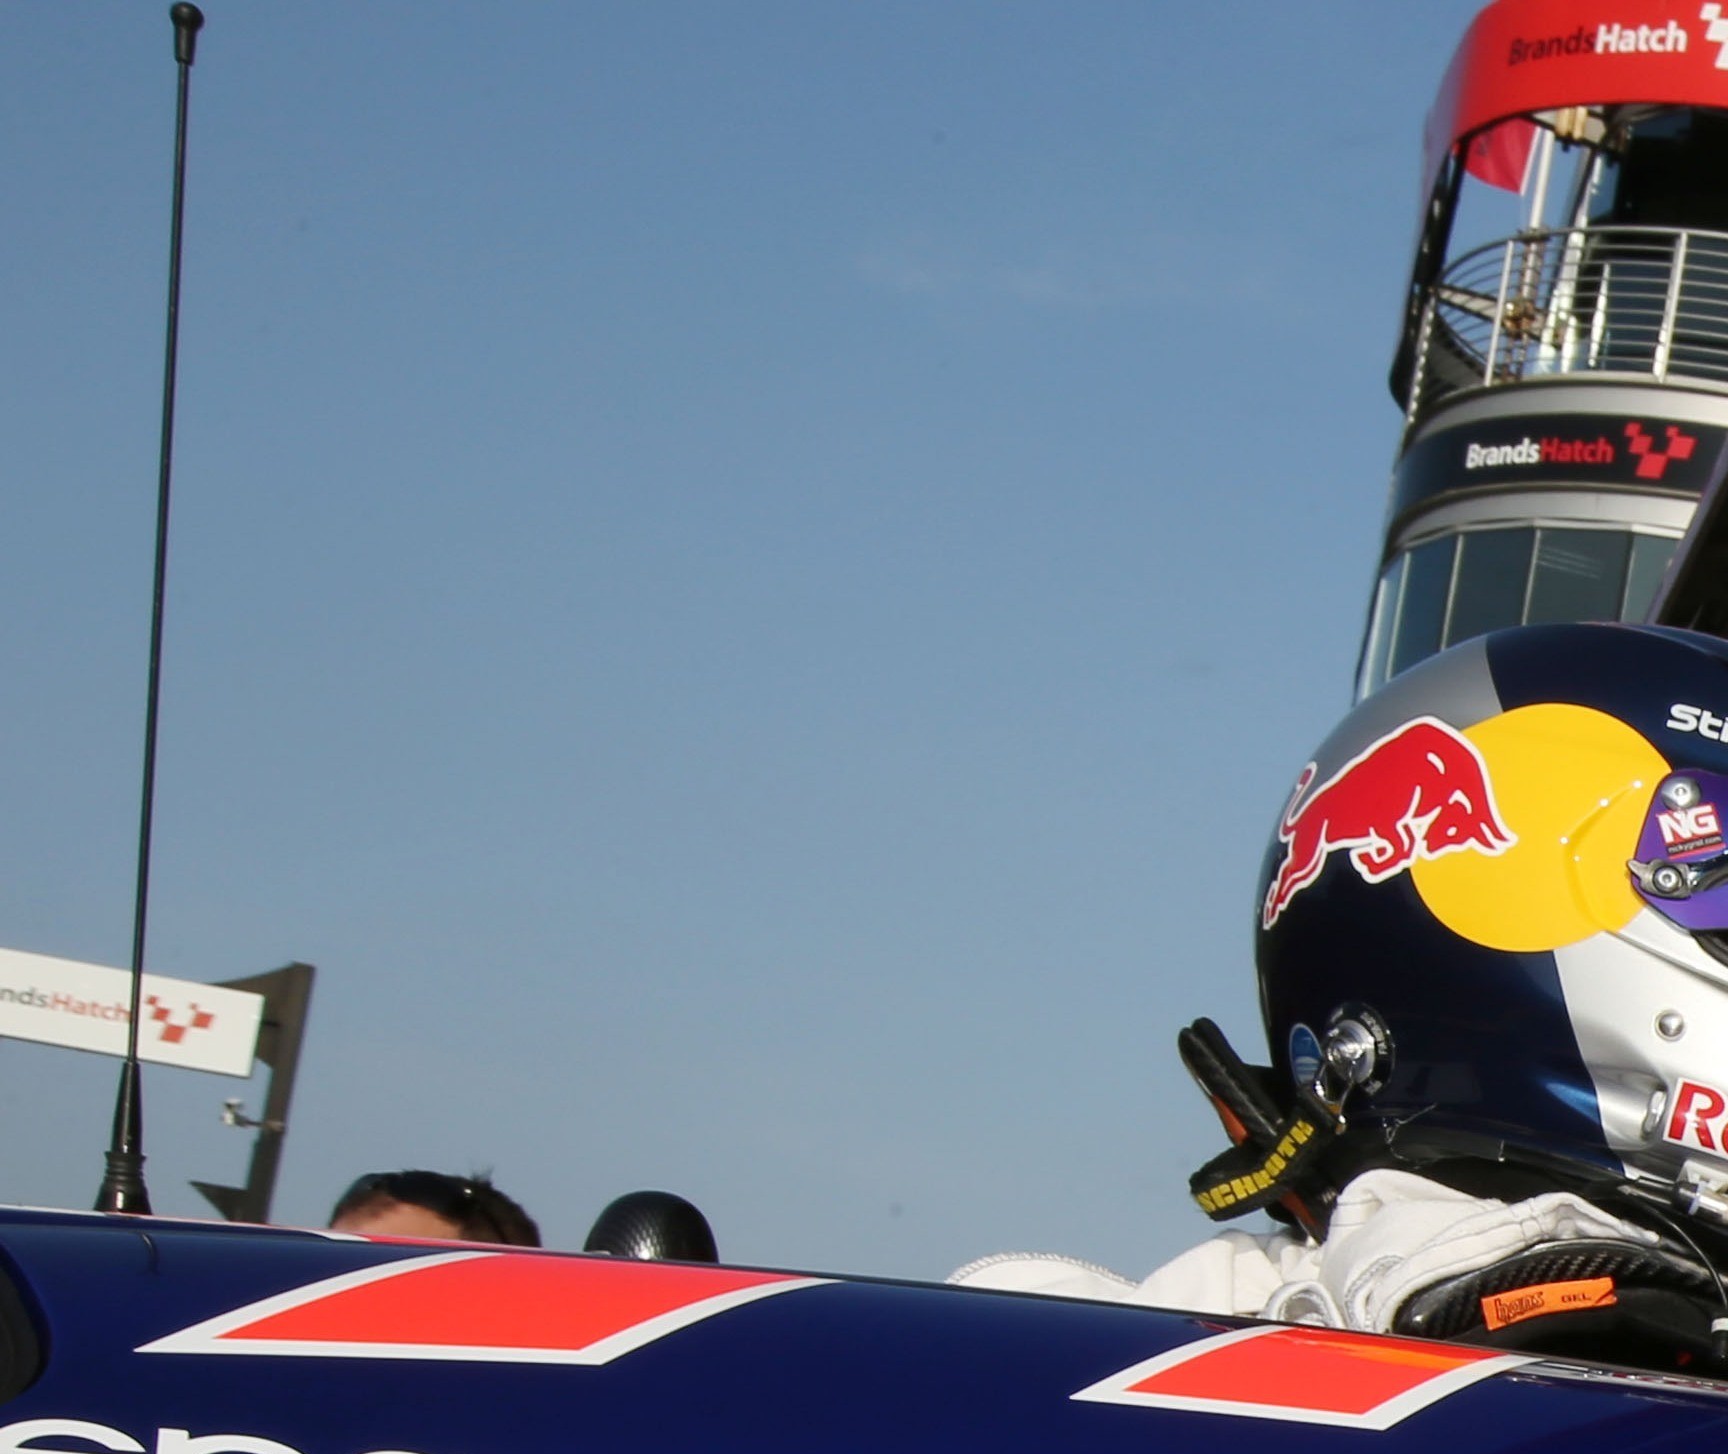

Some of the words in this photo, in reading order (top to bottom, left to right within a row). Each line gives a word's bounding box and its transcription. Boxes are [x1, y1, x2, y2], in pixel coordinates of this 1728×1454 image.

[1507, 19, 1688, 67] BrandsHatch
[1466, 437, 1613, 469] BrandsHatch
[1657, 804, 1720, 844] NG
